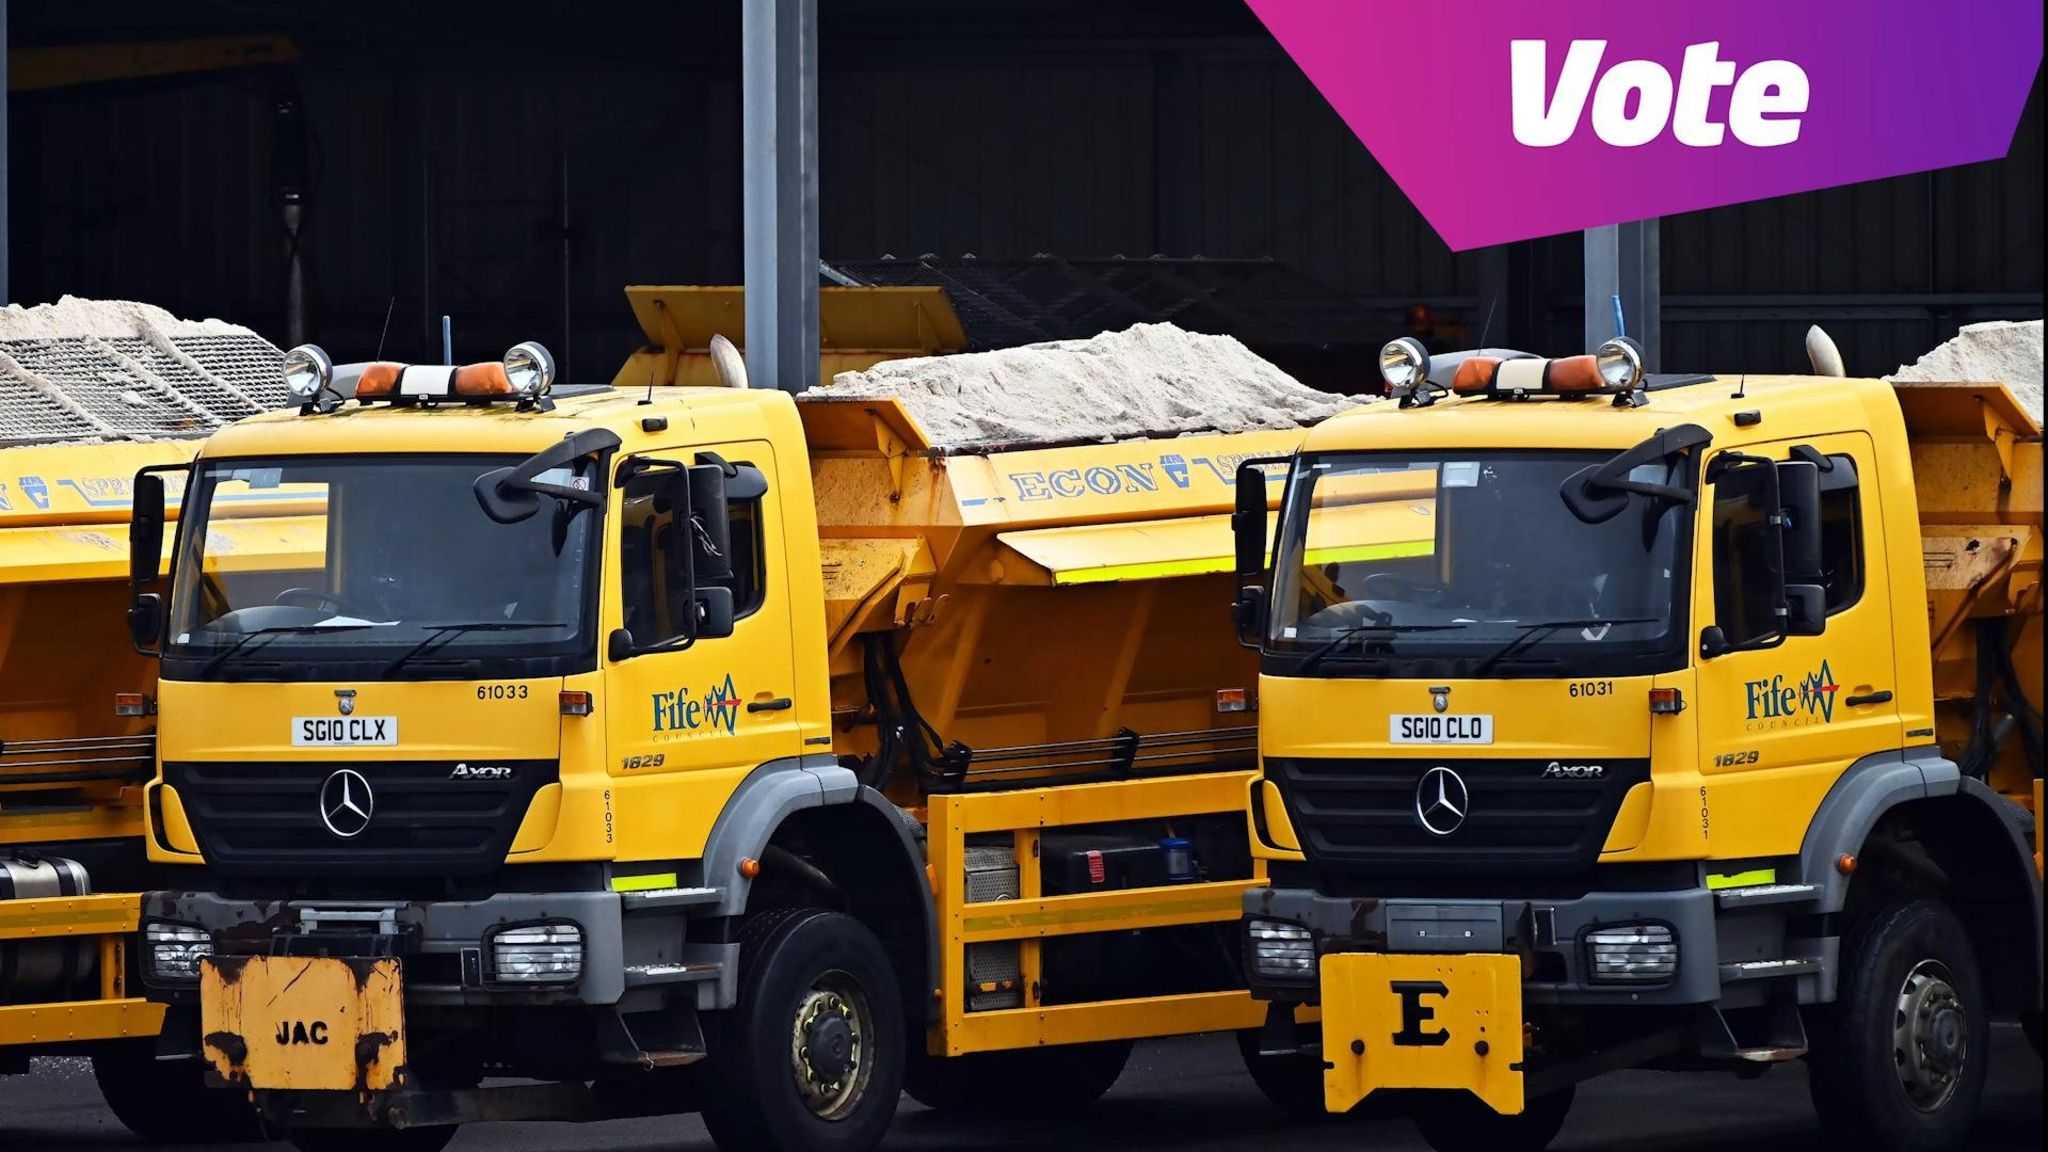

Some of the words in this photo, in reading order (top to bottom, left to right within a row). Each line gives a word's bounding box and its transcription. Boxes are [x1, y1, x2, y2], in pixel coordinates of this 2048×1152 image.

[1009, 463, 1159, 501] ECON
[477, 685, 528, 699] 61033
[1569, 681, 1613, 697] 61031
[1745, 674, 1796, 719] Fife
[652, 687, 701, 731] Fife
[303, 719, 343, 741] SG10
[350, 719, 386, 741] CLX
[1402, 717, 1440, 739] SG10
[1446, 717, 1482, 739] CLO
[1746, 716, 1820, 731] COUNCIL
[622, 753, 665, 769] 1829
[1714, 750, 1759, 767] 1829
[604, 789, 612, 843] 61033
[1700, 785, 1709, 839] 61031
[1390, 981, 1451, 1046] E
[276, 1021, 328, 1045] JAC
